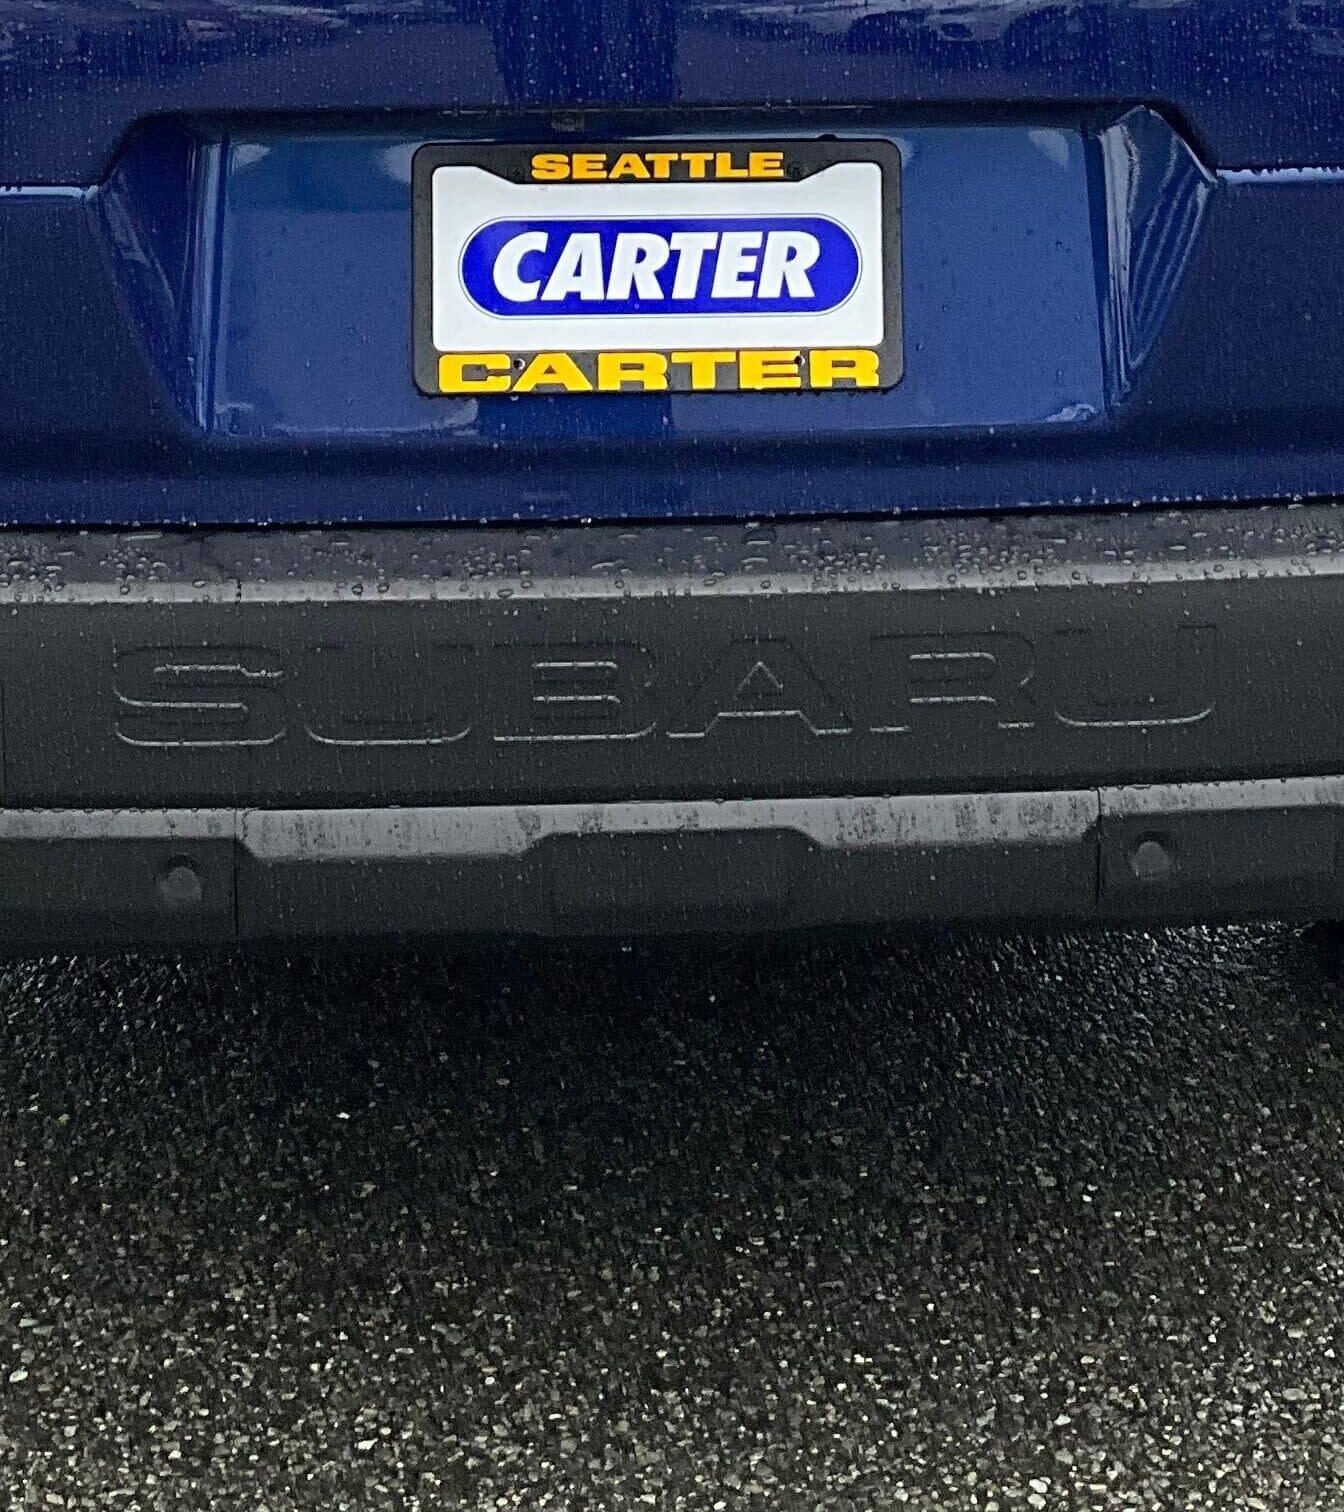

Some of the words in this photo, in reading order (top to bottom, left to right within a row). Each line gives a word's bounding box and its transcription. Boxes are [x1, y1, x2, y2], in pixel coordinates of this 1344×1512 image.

[530, 152, 785, 180] SEATTLE
[492, 229, 821, 303] CARTER
[437, 349, 880, 393] CARTER
[112, 624, 1219, 750] SUBARU
